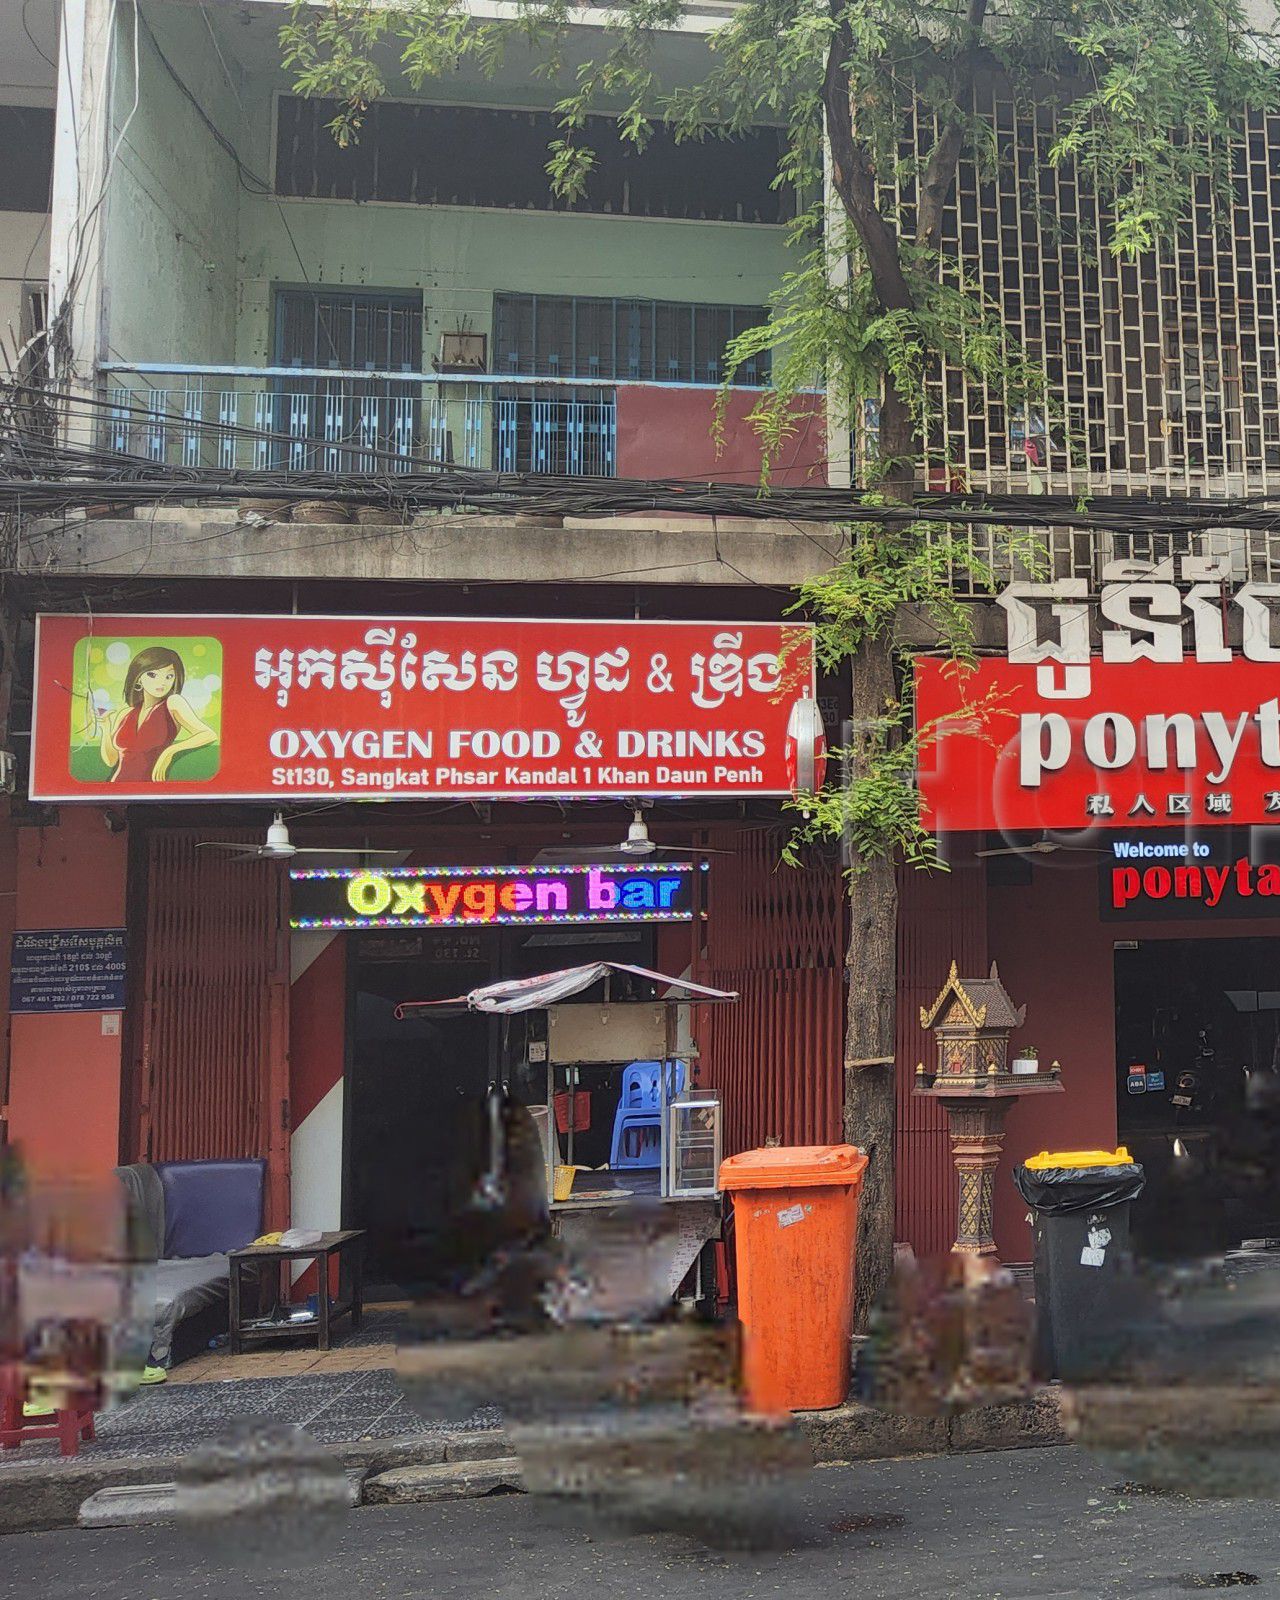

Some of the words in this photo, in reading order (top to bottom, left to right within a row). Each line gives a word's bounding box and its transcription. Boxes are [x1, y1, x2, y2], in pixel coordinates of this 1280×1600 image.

[646, 653, 675, 693] &
[269, 729, 433, 759] OXYGEN
[449, 729, 561, 759] FOOD
[574, 729, 604, 759] &
[618, 729, 766, 759] DRINKS
[271, 767, 335, 788] St130,
[341, 767, 429, 790] Sangkat
[435, 767, 499, 786] Phsar
[505, 766, 577, 785] Kandal
[583, 767, 592, 784] 1
[598, 767, 650, 785] Khan
[656, 766, 708, 784] Daun
[714, 766, 763, 784] Penh
[1088, 793, 1233, 816] 私人区域
[1113, 841, 1190, 858] Welcome
[1193, 841, 1210, 857] to
[346, 872, 568, 921] Oxygen
[588, 868, 682, 910] bar
